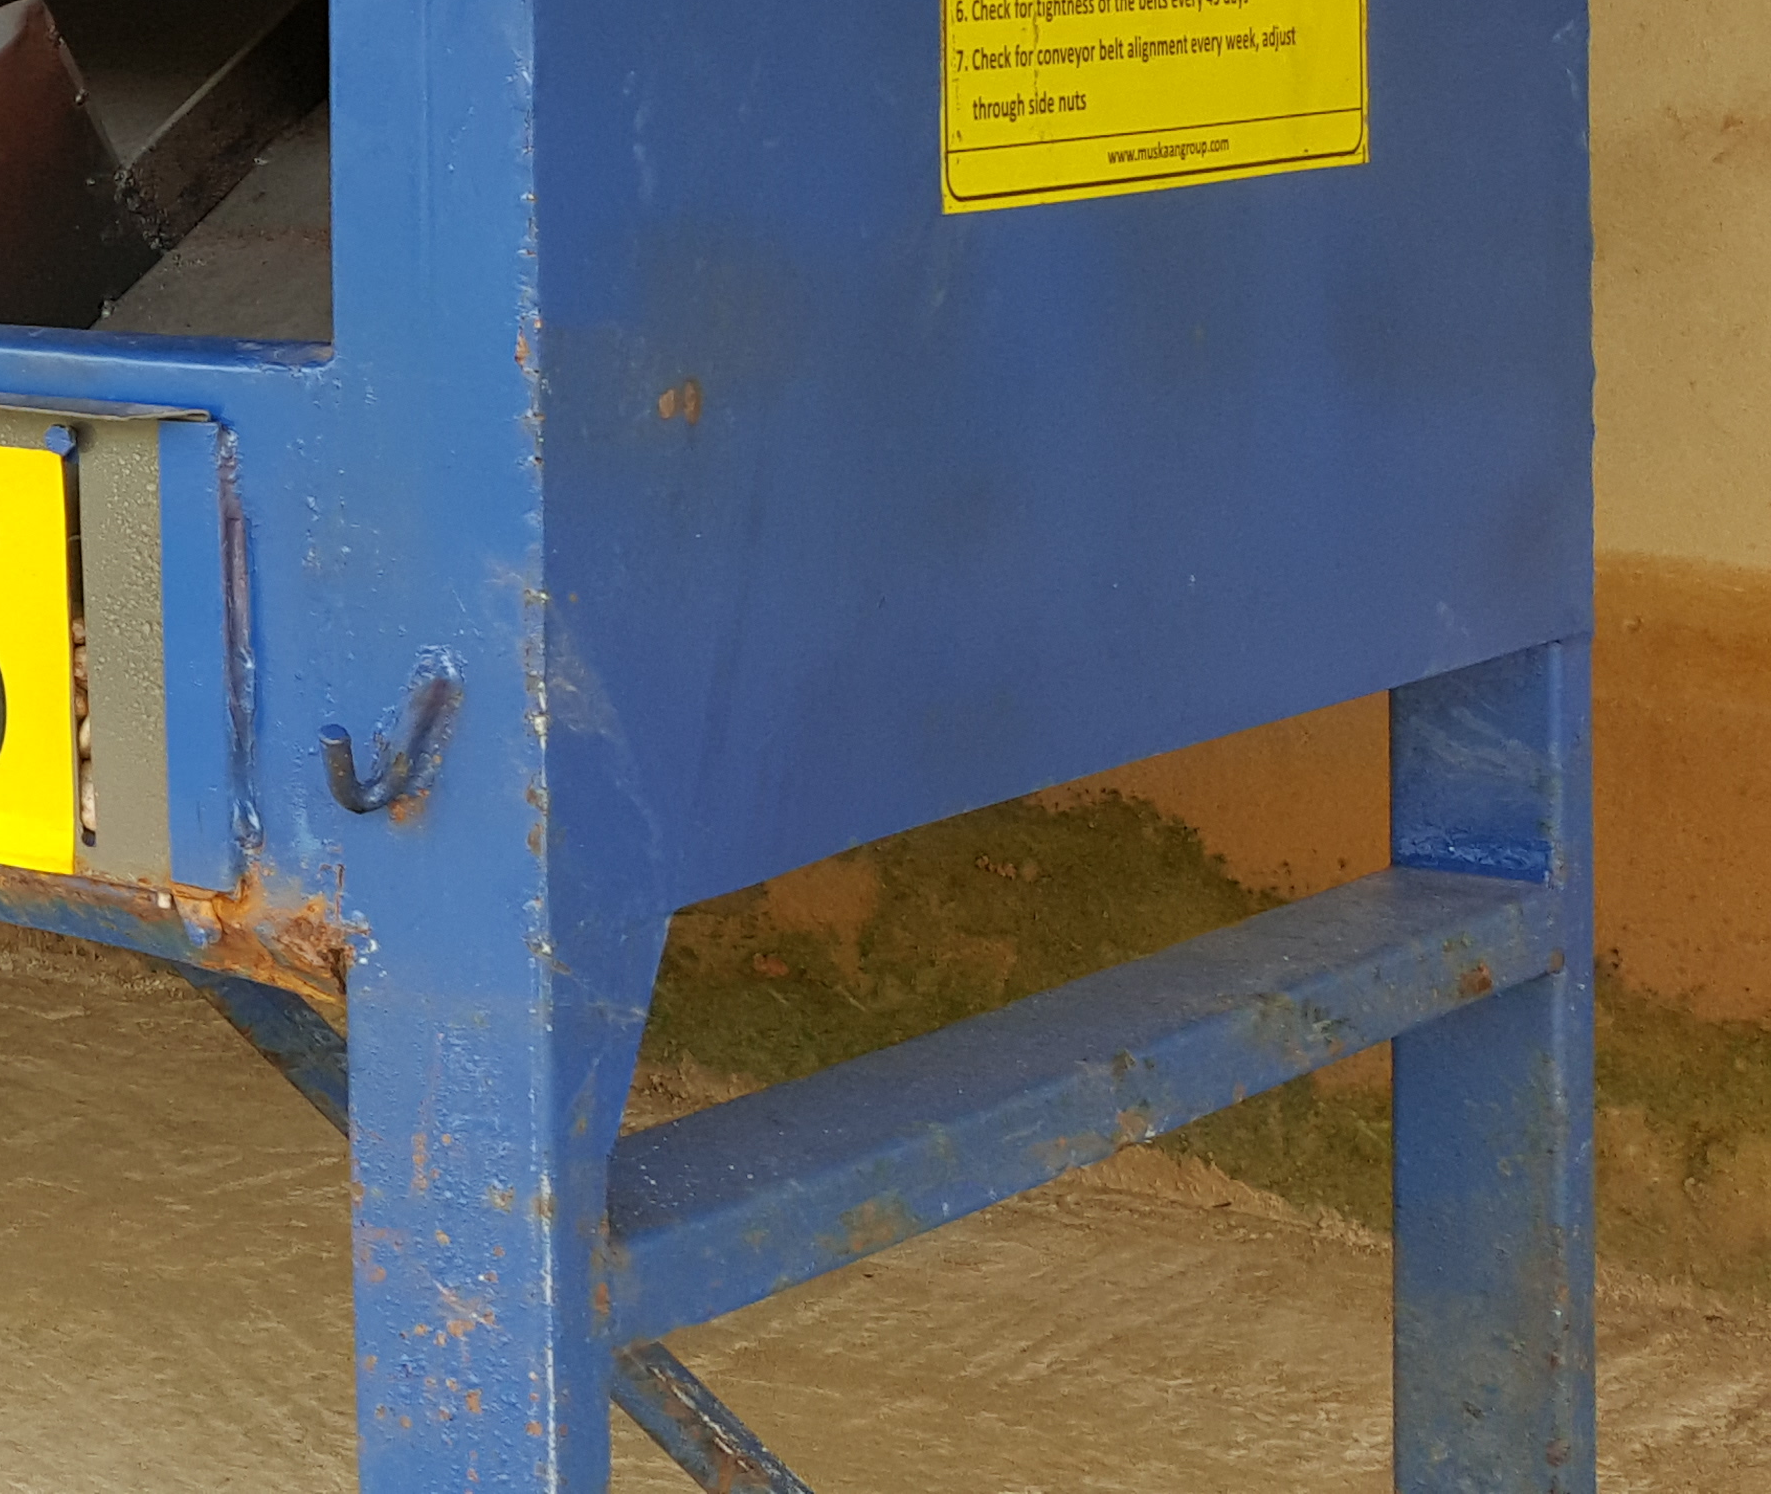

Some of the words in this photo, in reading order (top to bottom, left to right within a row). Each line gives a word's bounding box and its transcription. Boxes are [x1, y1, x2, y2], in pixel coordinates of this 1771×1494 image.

[956, 0, 967, 22] 6.
[956, 50, 968, 72] 7.
[972, 45, 1011, 71] Check
[1015, 45, 1034, 67] for
[1037, 45, 1095, 68] conveyor
[1099, 37, 1124, 60] belt
[1127, 35, 1188, 62] alignment
[1191, 35, 1222, 57] every
[1226, 27, 1259, 52] week,
[1262, 25, 1296, 52] adjust
[973, 93, 1025, 122] through
[1029, 91, 1054, 115] side
[1059, 91, 1086, 112] nuts
[1107, 138, 1229, 164] www.muskaangroup.com
